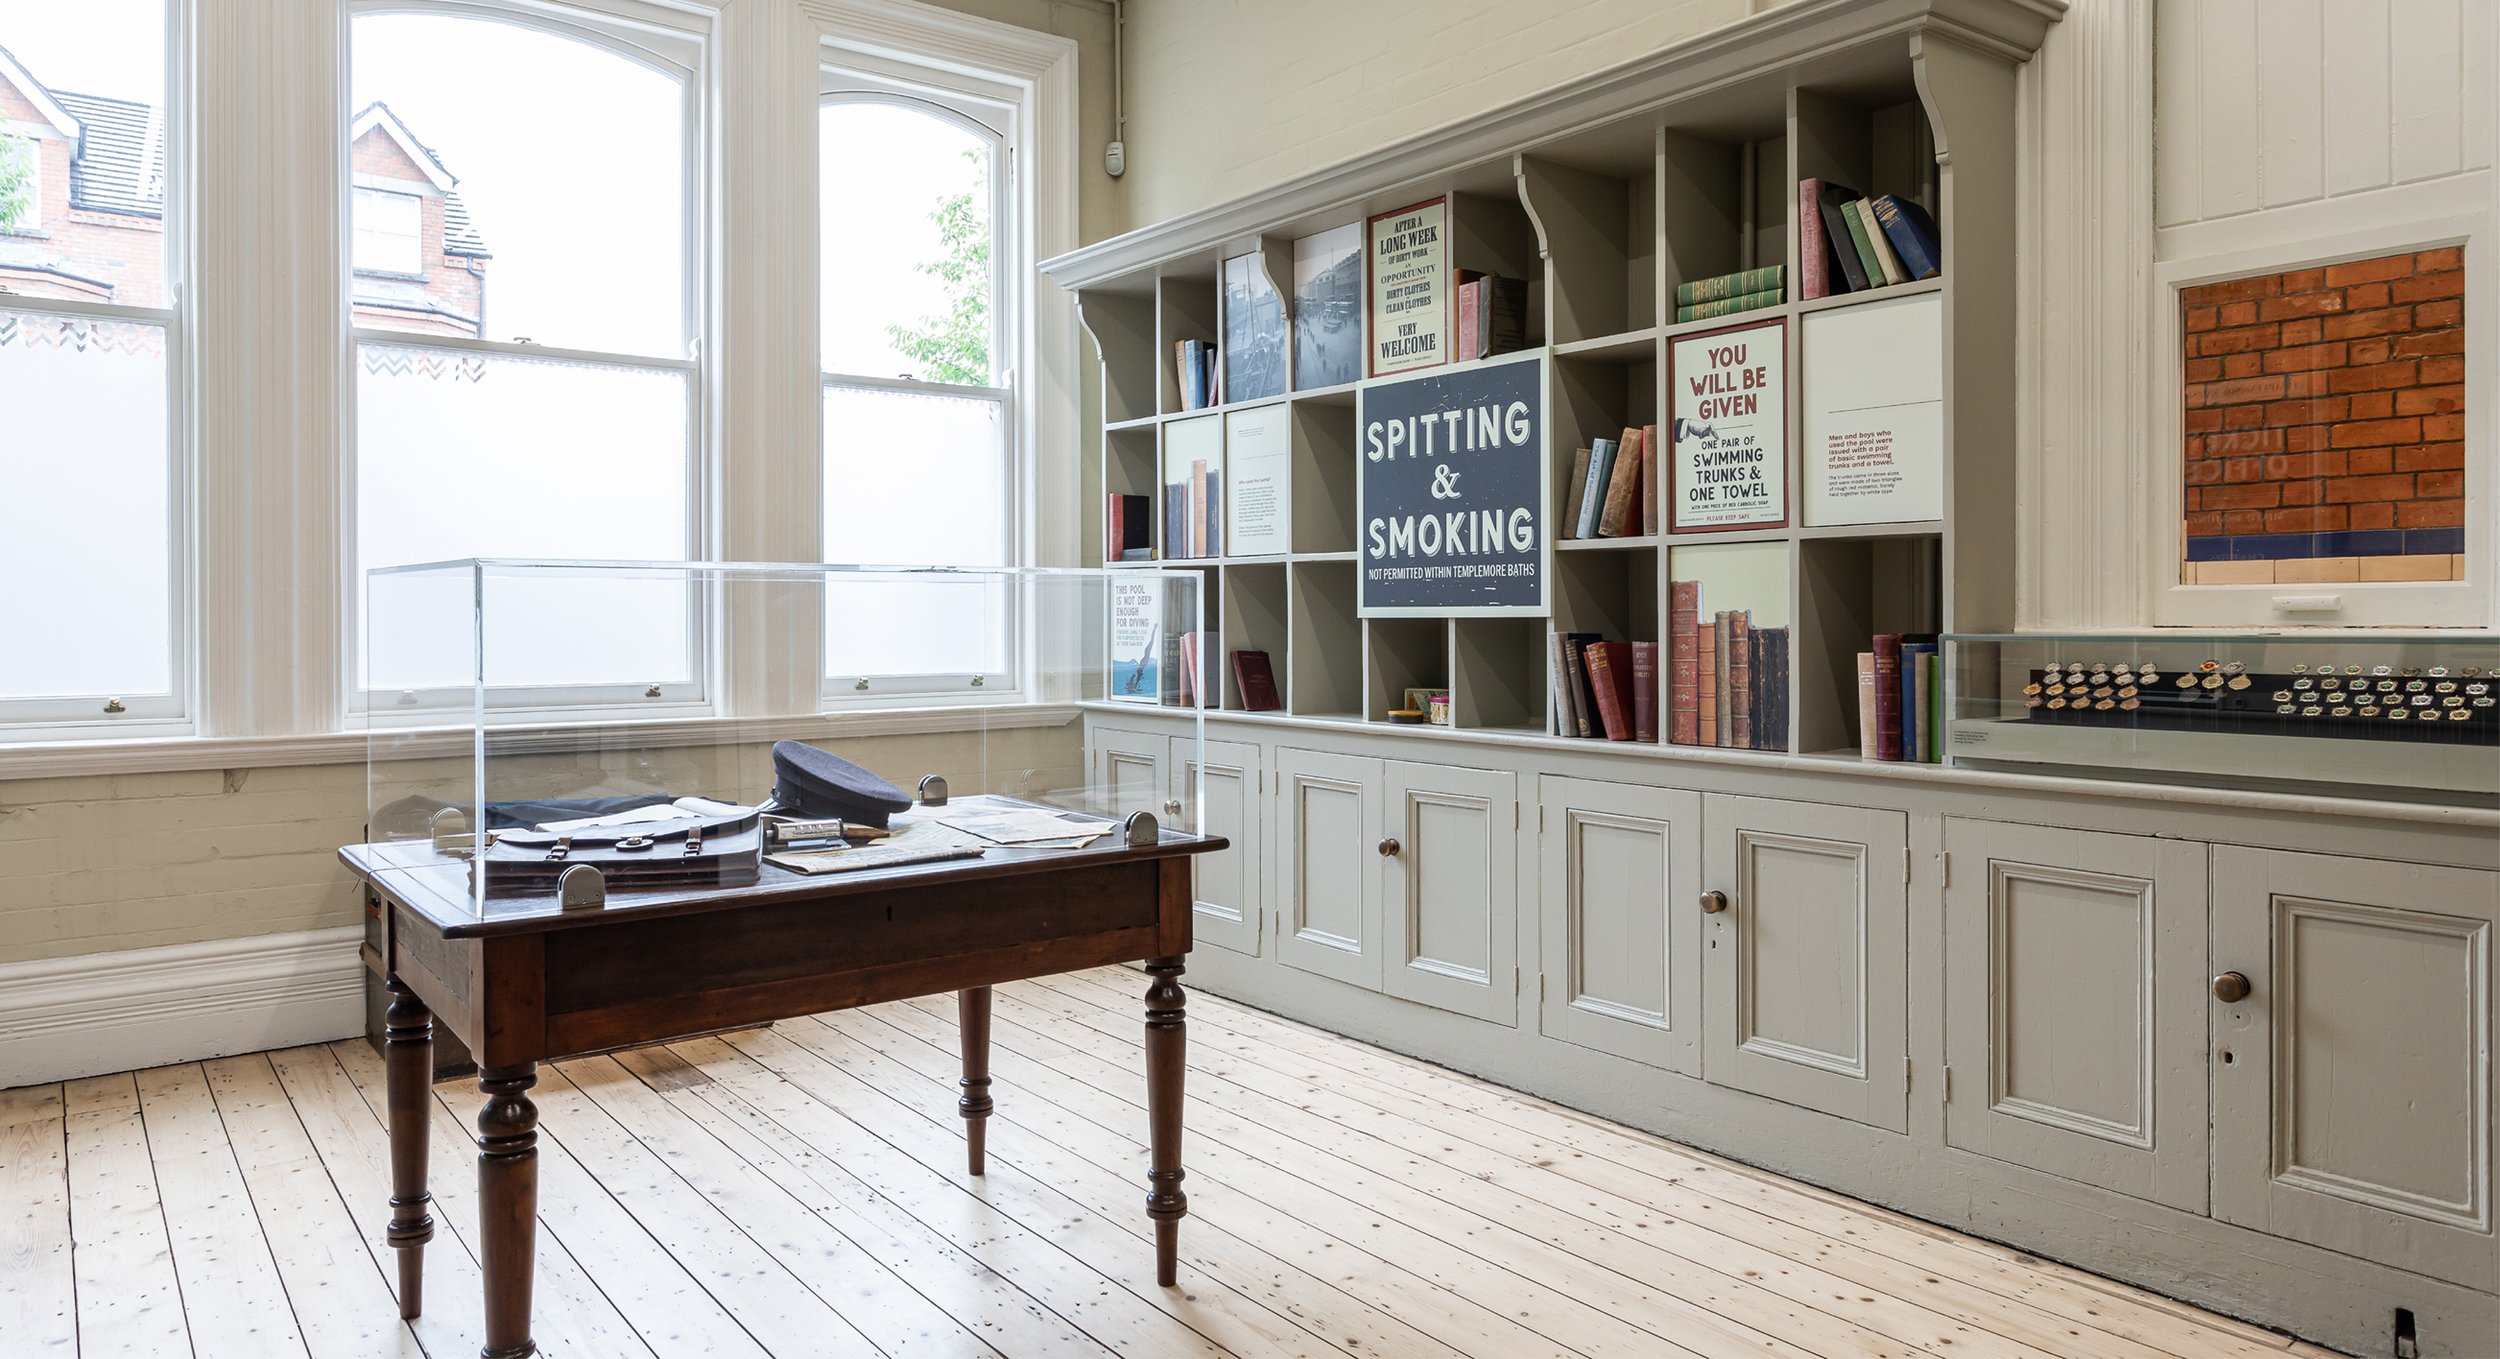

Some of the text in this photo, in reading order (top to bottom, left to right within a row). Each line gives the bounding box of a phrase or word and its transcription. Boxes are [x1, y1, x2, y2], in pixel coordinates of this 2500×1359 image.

[1394, 216, 1422, 233] AFTER A
[1381, 226, 1437, 255] LONG WEEK
[1389, 248, 1428, 265] OF DIRTY WORK
[1381, 264, 1436, 284] OPPORTUNITY
[1387, 282, 1430, 300] DIRTY CLOTHES
[1386, 296, 1431, 314] CLEAN CLOTHES
[1398, 322, 1417, 337] VERY
[1381, 333, 1436, 359] WELCOME
[1708, 344, 1746, 369] YOU
[1690, 366, 1766, 396] WILL BE
[1699, 393, 1757, 420] GIVEN
[1367, 400, 1531, 462] SPITTING
[1701, 436, 1755, 450] ONE PAIR OF
[1694, 448, 1763, 467] SWIMMING
[1431, 464, 1462, 500] &
[1696, 466, 1761, 484] TRUNKS &
[1690, 483, 1768, 501] ONE TOWEL
[1368, 507, 1535, 559] SMOKING
[1369, 563, 1535, 580] NOT PERMITTED WITHIN TEMPLEMORE BATHS
[1116, 585, 1145, 594] THIS POOL
[1117, 596, 1152, 605] IS NOT DEEP
[1117, 607, 1139, 616] ENOUGH
[1117, 618, 1149, 627] FOR DIVING
